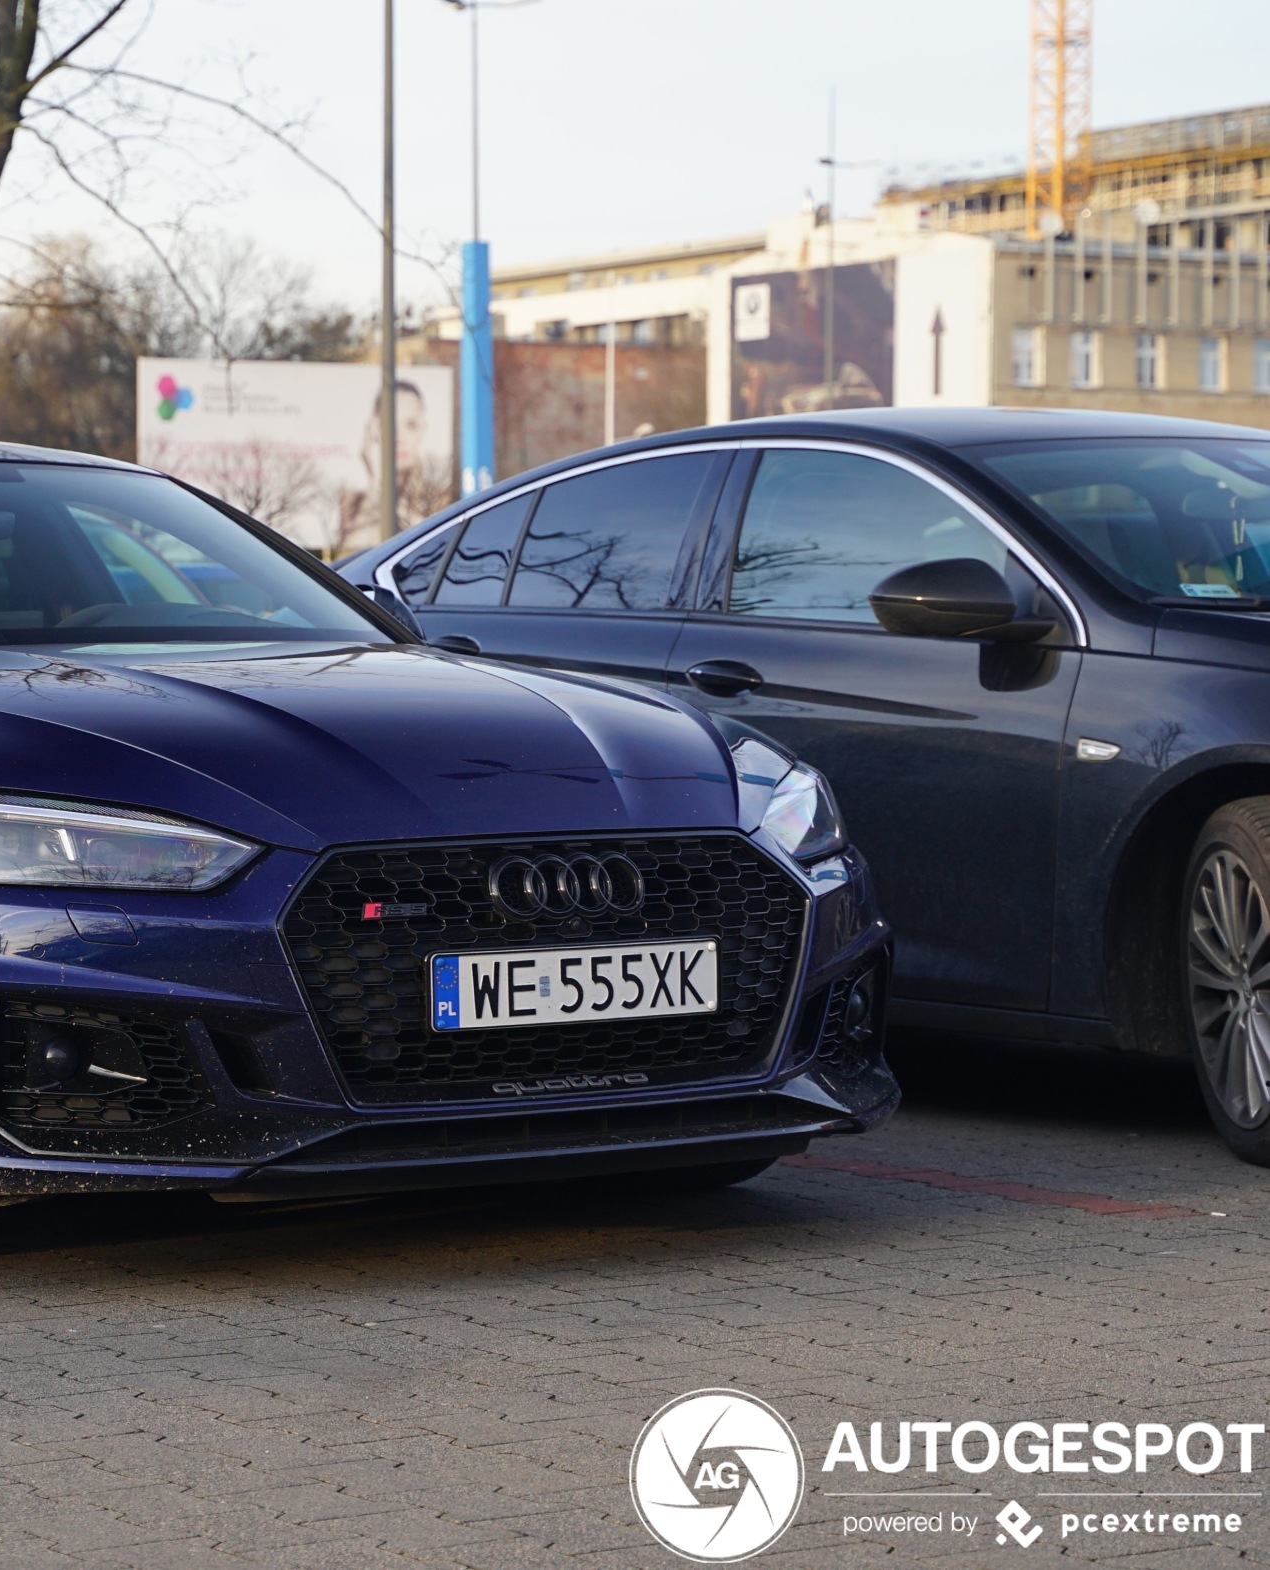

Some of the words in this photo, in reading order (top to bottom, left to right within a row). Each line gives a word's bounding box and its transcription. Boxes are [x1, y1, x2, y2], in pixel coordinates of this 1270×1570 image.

[471, 959, 536, 1019] WE
[560, 949, 704, 1014] 555XK
[438, 1001, 456, 1016] PL
[492, 1072, 649, 1096] quattro
